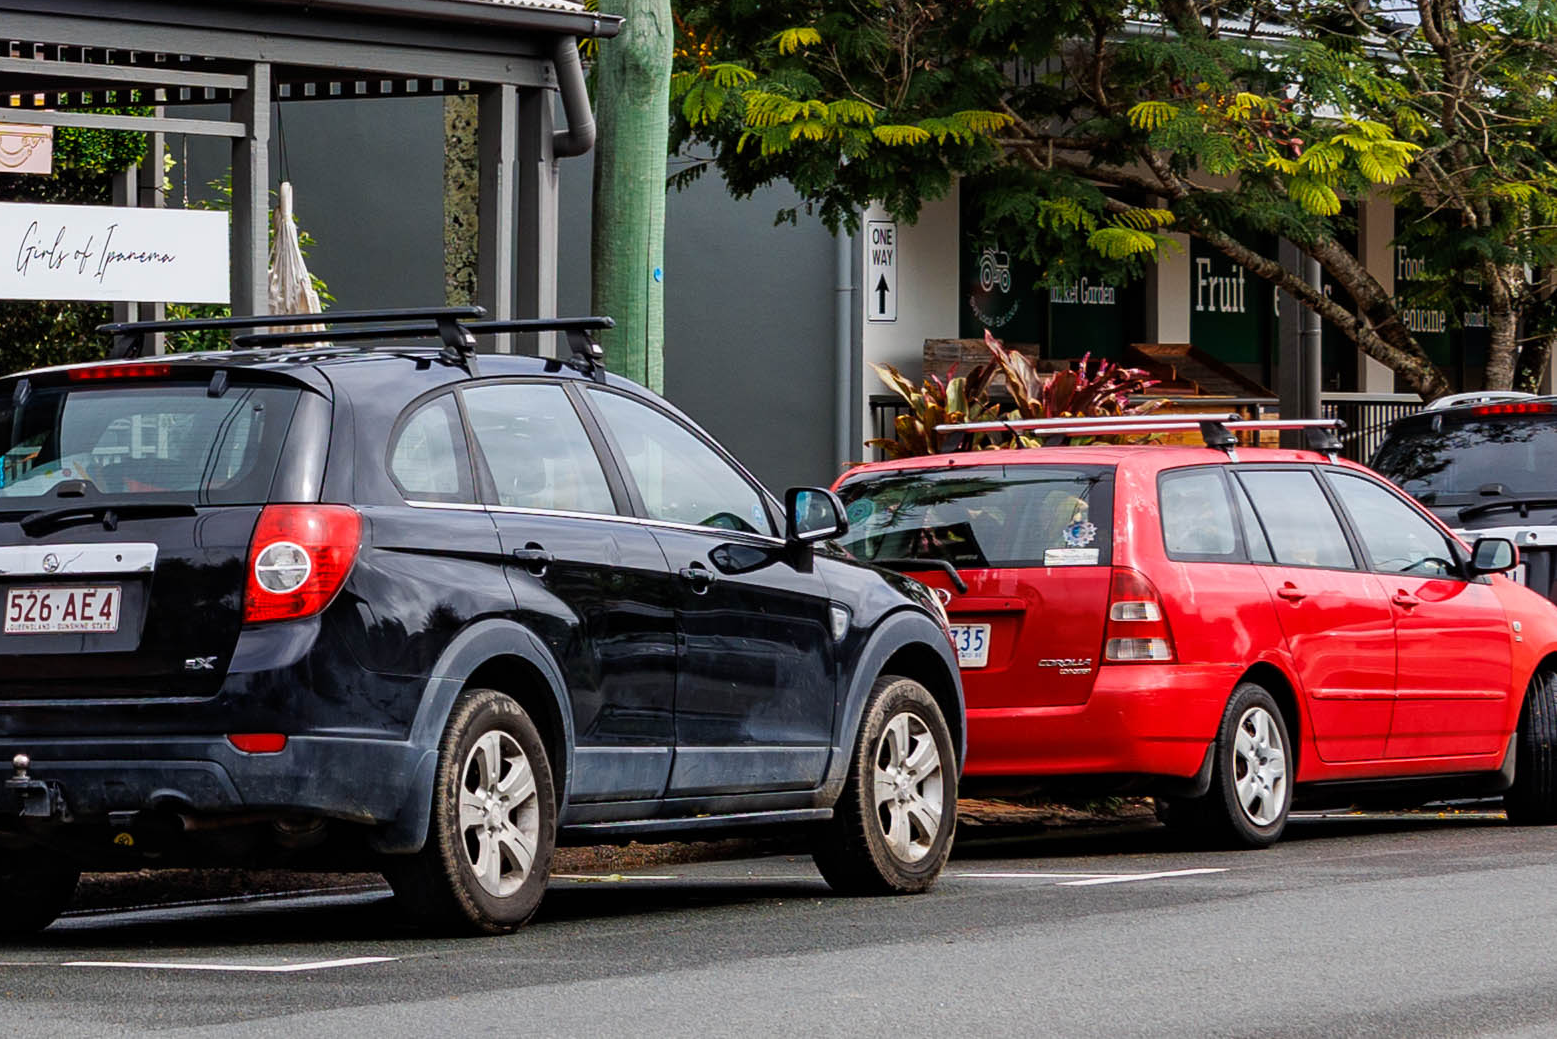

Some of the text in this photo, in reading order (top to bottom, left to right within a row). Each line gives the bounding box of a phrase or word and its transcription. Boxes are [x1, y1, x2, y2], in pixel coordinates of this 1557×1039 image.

[872, 228, 893, 245] ONE
[16, 220, 177, 284] Girls of Ipanema
[872, 249, 893, 266] WAY
[1080, 276, 1116, 305] Garden
[1196, 257, 1245, 313] Fruit
